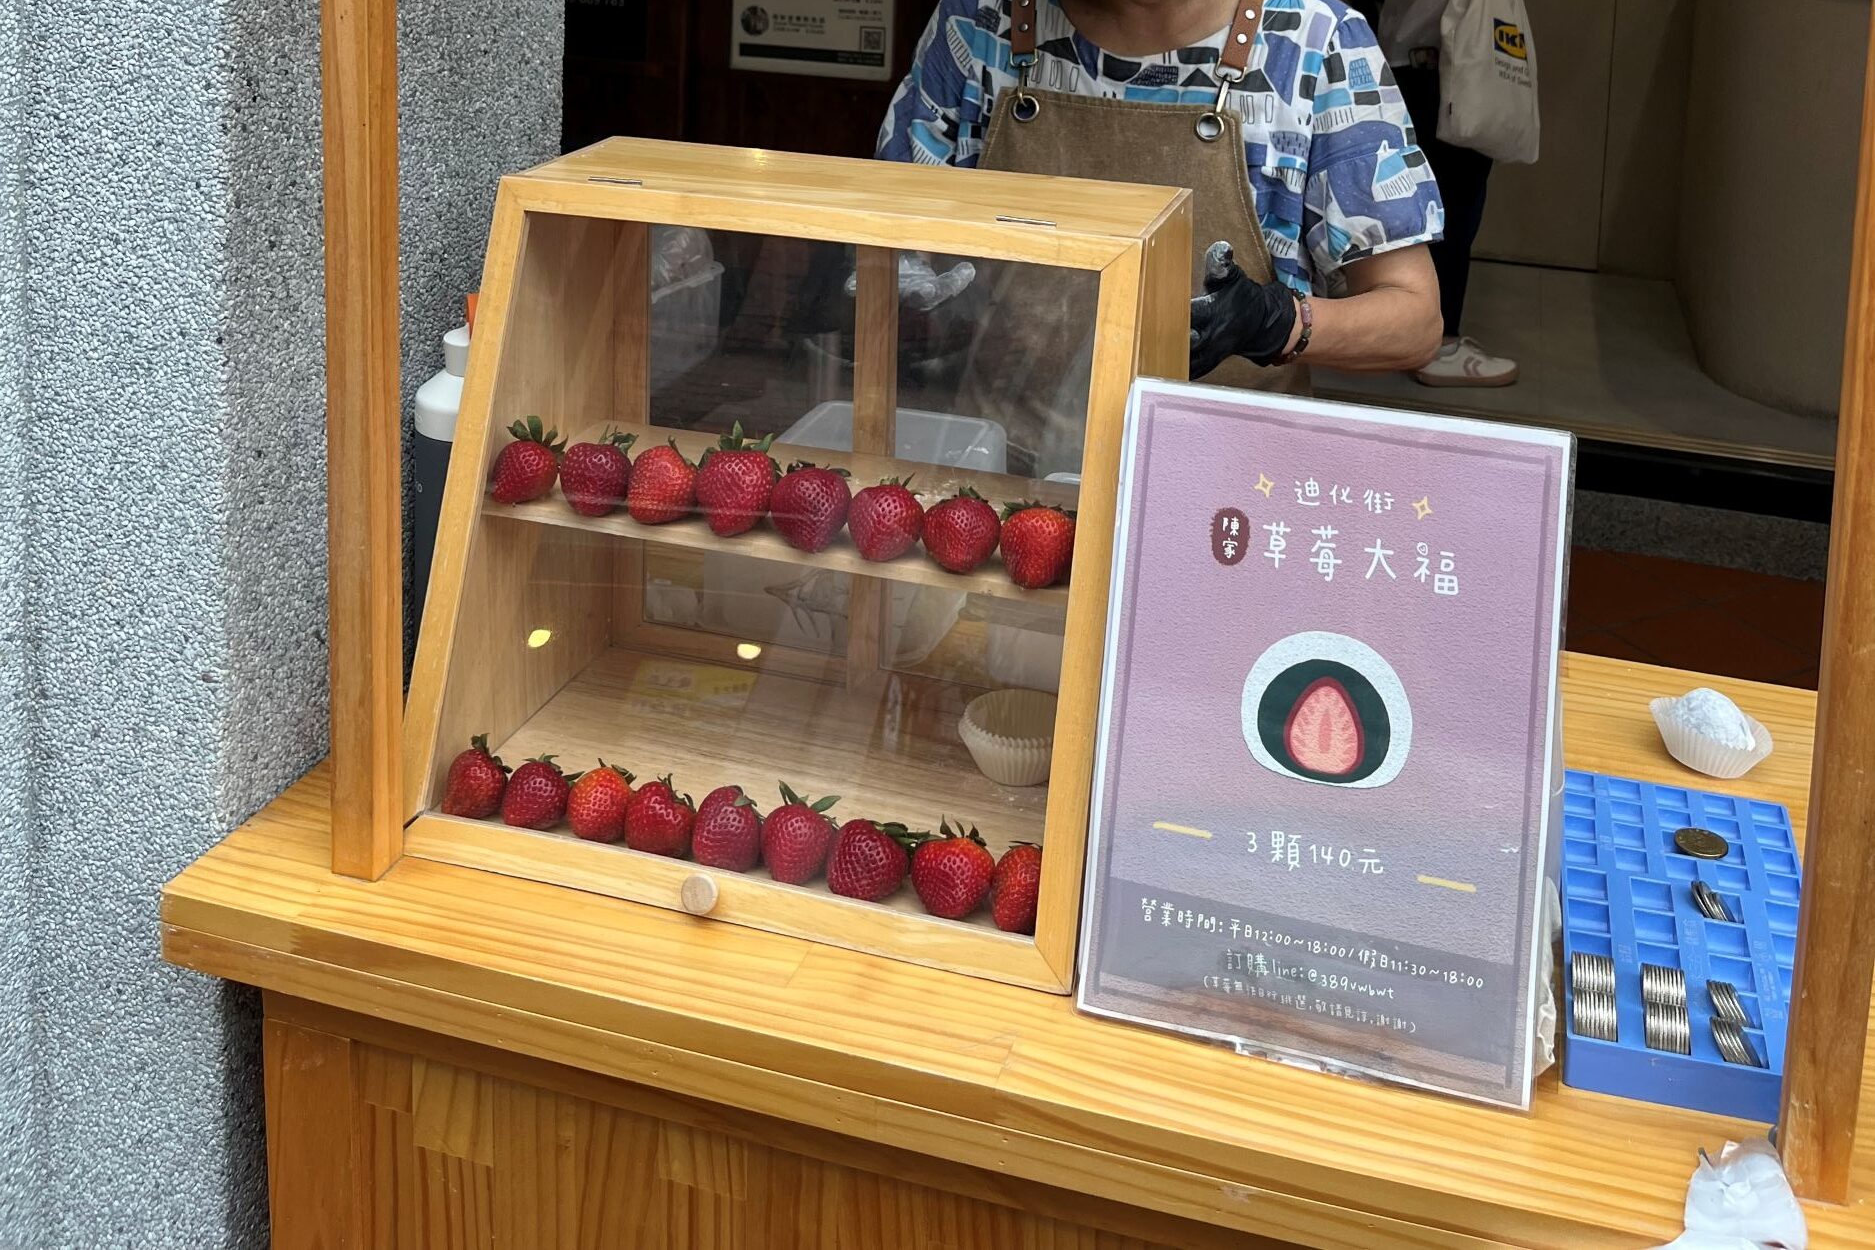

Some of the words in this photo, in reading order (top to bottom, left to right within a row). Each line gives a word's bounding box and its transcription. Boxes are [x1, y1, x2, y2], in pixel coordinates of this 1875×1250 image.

[1293, 478, 1397, 512] 迪化街
[1221, 515, 1241, 561] 陳家
[1262, 521, 1461, 597] 草莓大福
